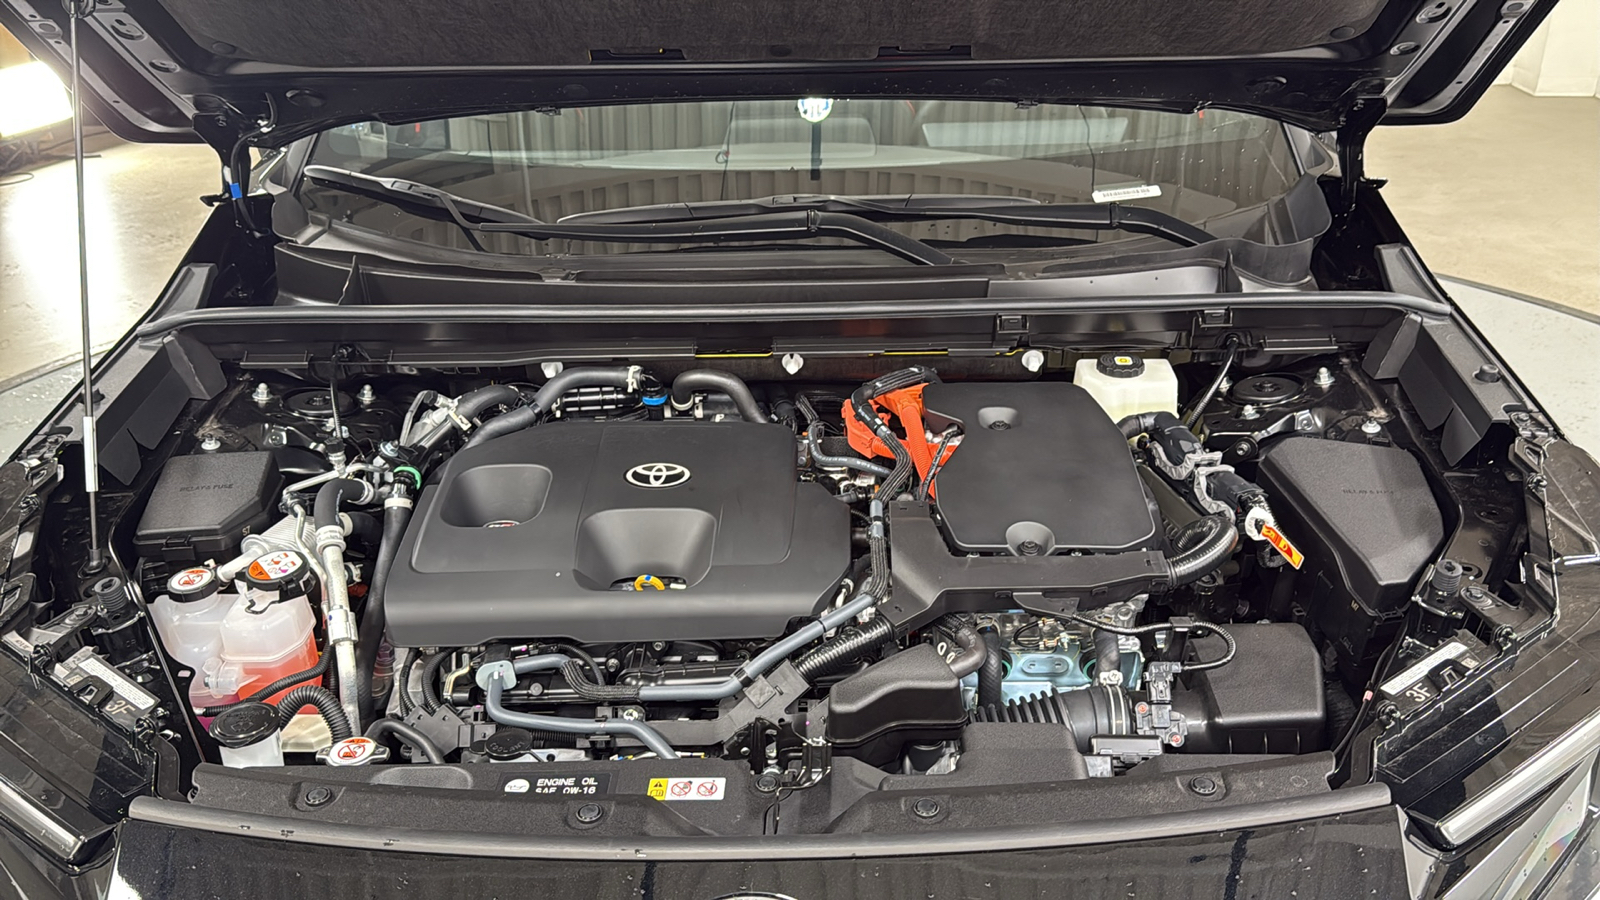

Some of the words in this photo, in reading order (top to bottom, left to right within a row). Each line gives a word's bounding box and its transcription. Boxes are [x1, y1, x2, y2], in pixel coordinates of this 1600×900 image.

[1405, 683, 1432, 702] 3F
[105, 699, 136, 715] 3F
[537, 778, 576, 786] ENGINE
